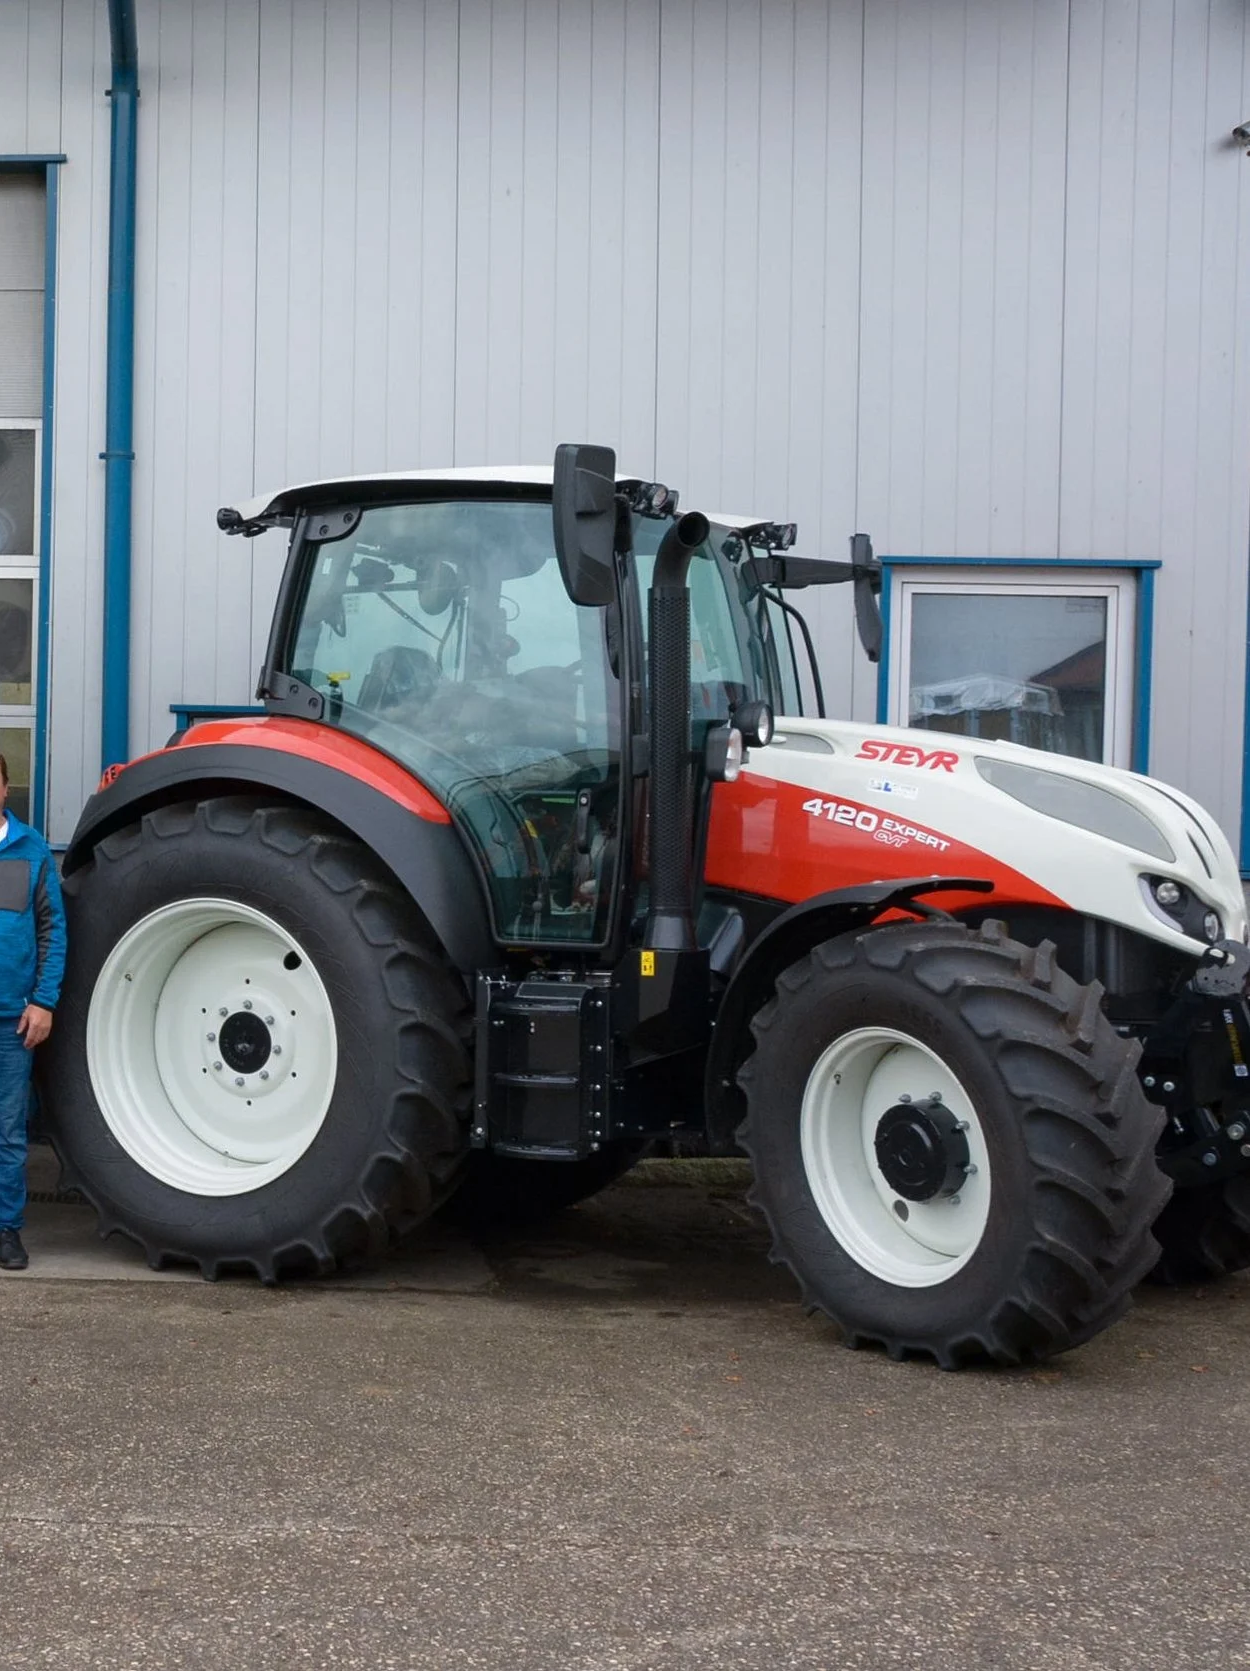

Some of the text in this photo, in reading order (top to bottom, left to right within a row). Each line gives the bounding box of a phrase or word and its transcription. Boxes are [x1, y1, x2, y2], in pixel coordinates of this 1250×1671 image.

[854, 740, 959, 773] STEYR
[802, 798, 951, 852] 4120 EXPERT
